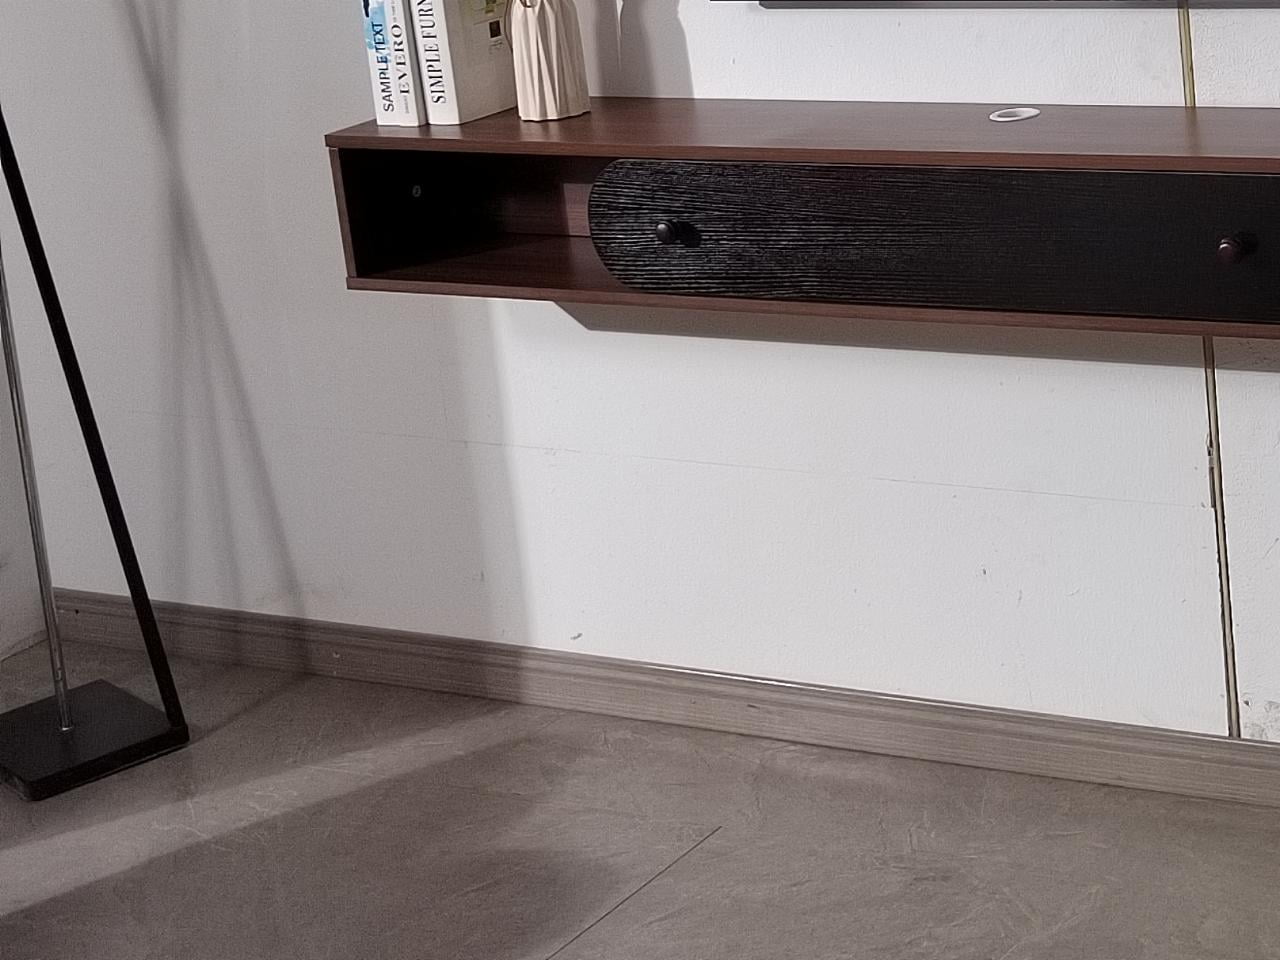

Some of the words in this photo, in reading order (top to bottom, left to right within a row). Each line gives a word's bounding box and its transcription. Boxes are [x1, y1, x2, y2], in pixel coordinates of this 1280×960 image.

[372, 21, 386, 53] TEXT
[391, 23, 410, 95] EVERO
[377, 54, 394, 113] SAMPLE
[426, 44, 447, 104] SIMPLE
